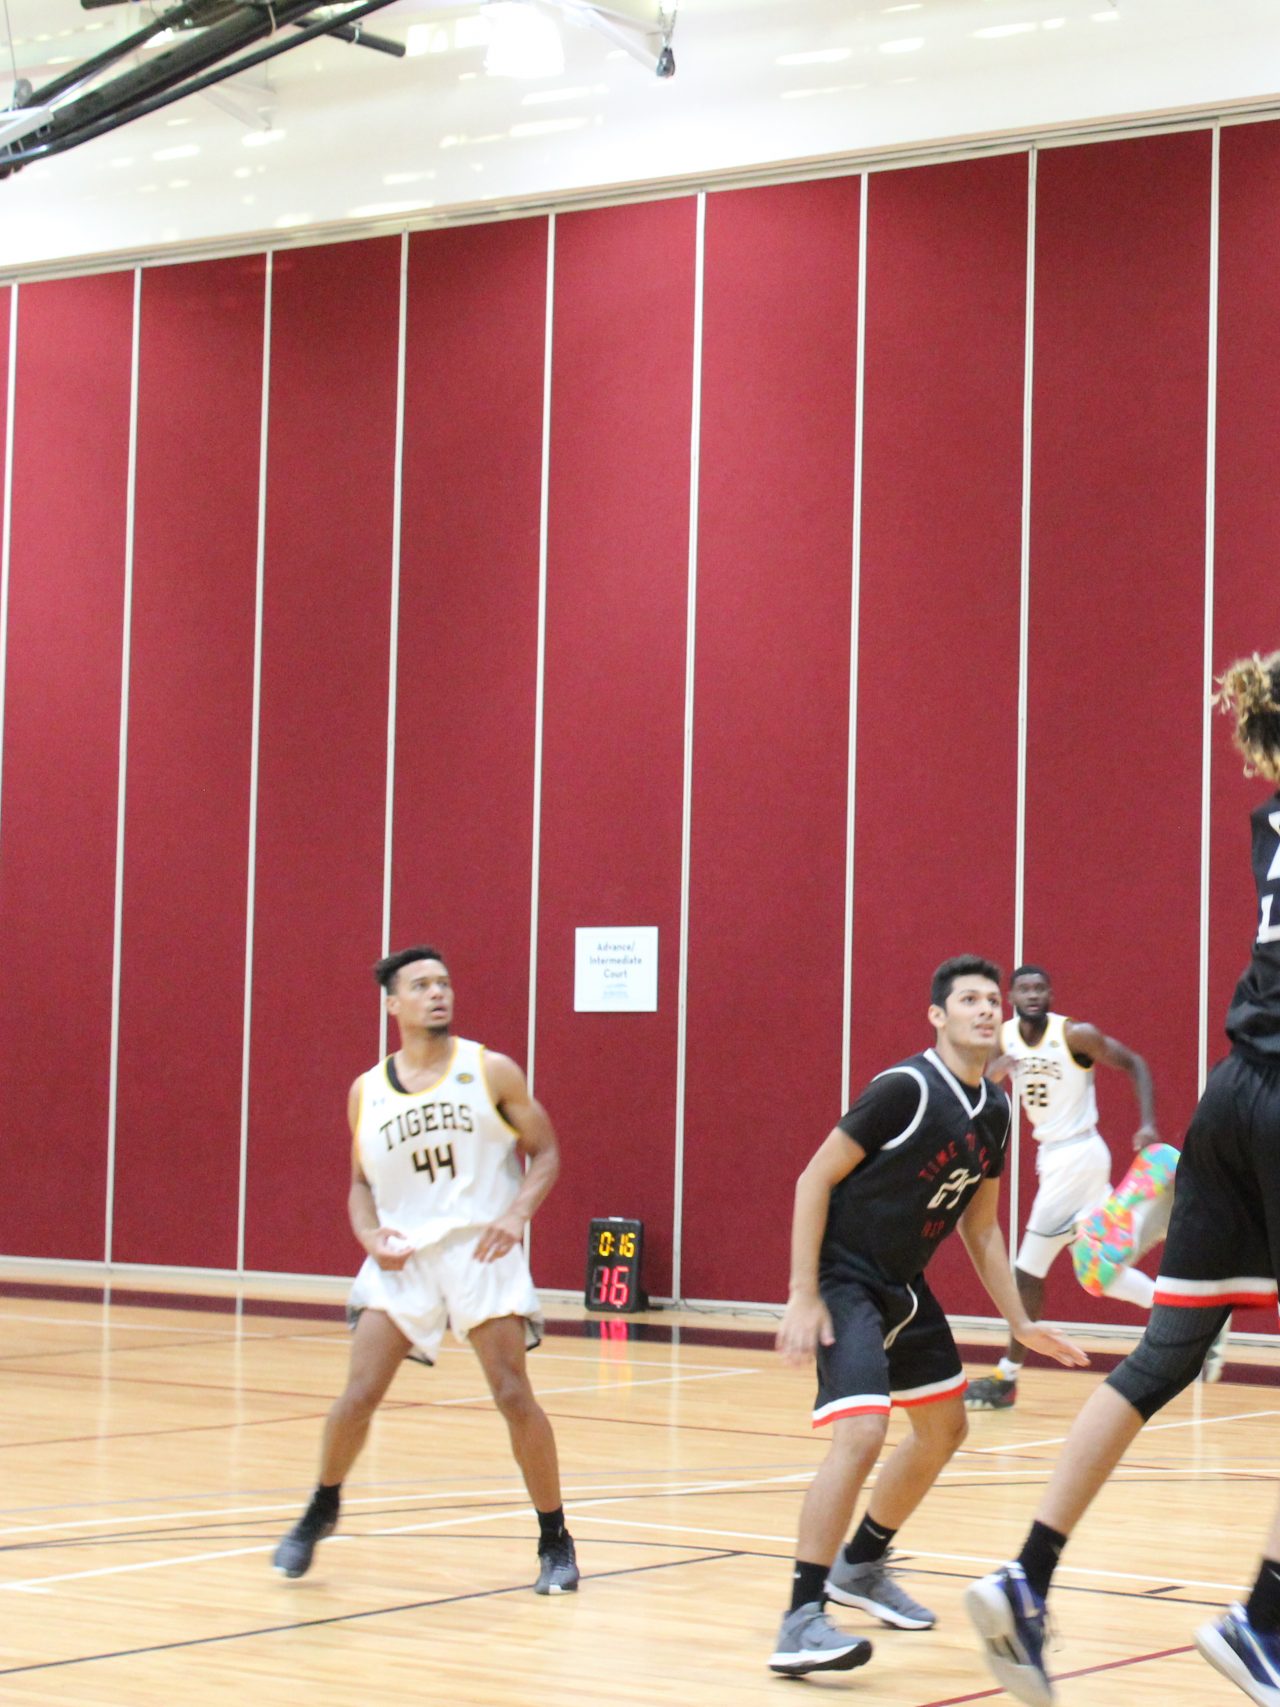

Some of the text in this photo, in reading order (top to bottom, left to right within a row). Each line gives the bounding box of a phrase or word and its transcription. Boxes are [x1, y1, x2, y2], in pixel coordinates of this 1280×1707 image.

[589, 955, 642, 965] Intermediate
[597, 940, 635, 953] Advance/
[603, 968, 628, 978] Court
[379, 1102, 474, 1151] TIGERS
[411, 1143, 456, 1184] 44
[599, 1231, 636, 1258] 0:16
[600, 1265, 630, 1306] 16
